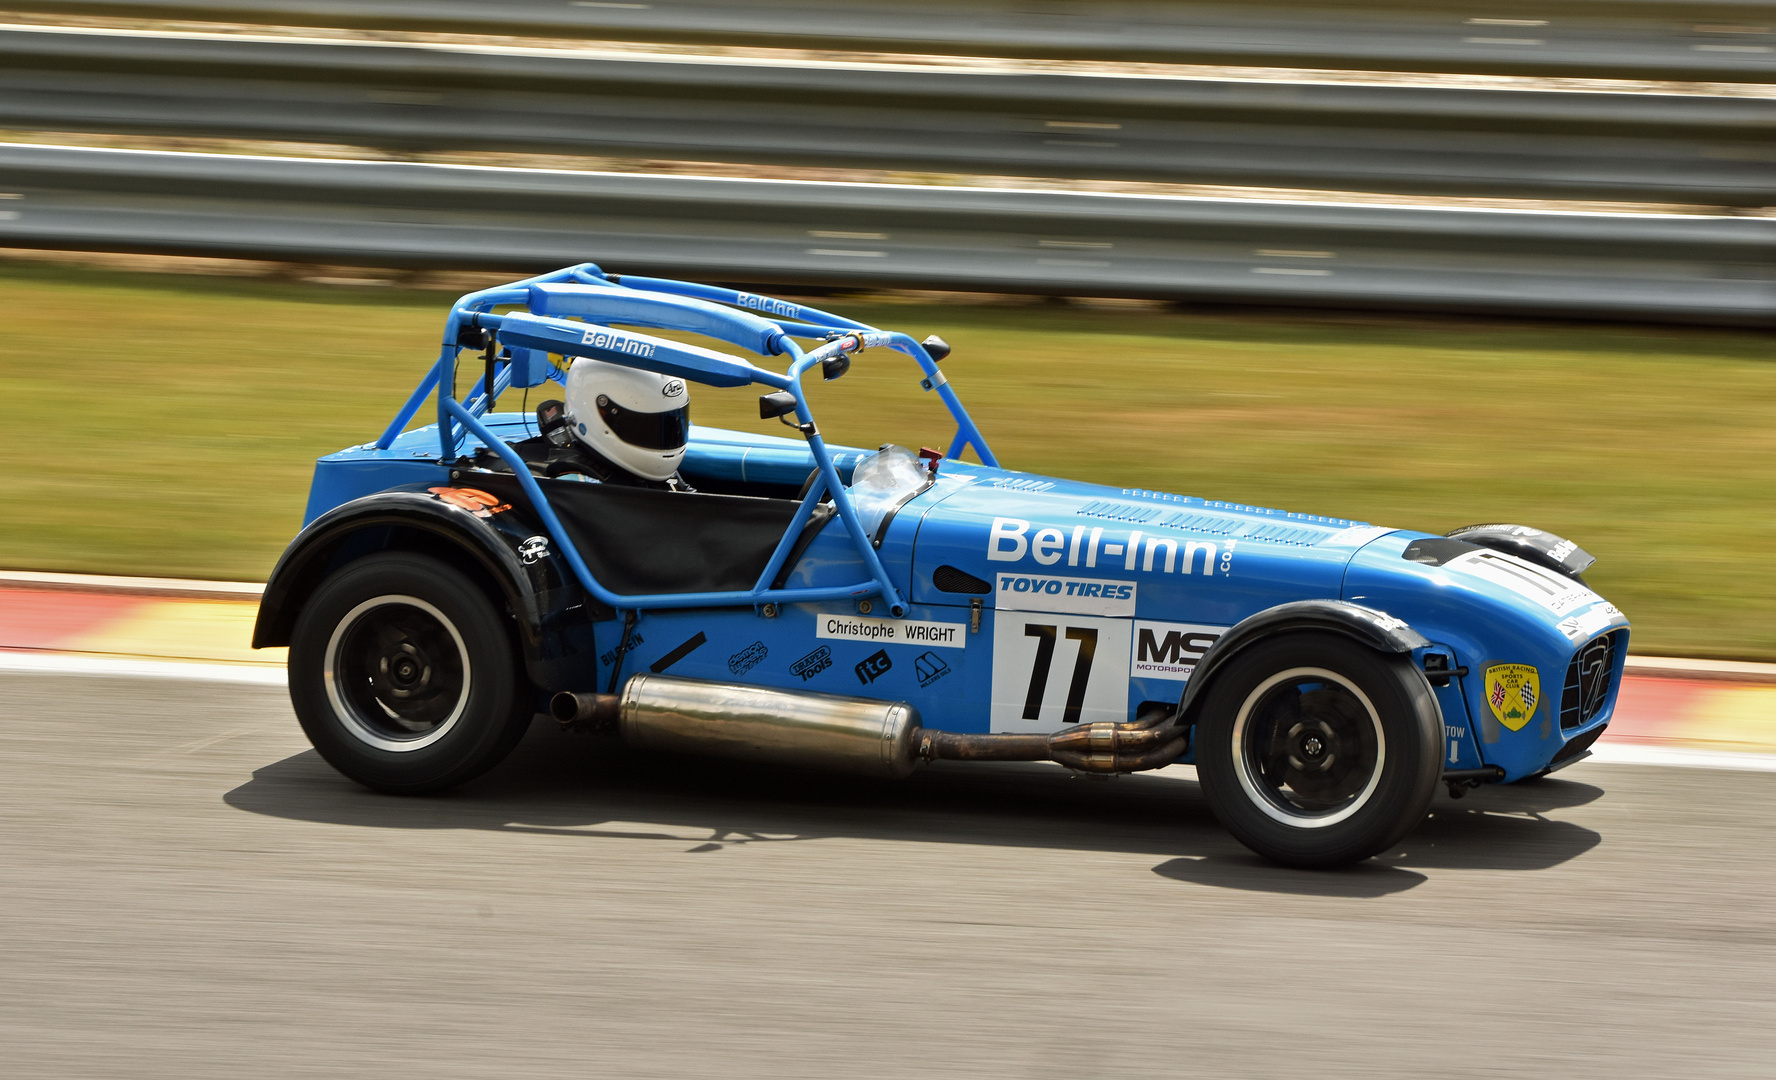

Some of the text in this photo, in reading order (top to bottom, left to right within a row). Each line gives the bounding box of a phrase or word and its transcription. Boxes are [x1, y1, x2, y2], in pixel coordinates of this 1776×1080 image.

[737, 292, 796, 318] Bell-Inn
[581, 329, 651, 357] Bell-Inn
[987, 517, 1218, 576] Bell-Inn
[1000, 577, 1134, 600] TOYO TIRES
[827, 619, 956, 642] Christophe WRIGHT
[601, 633, 645, 667] BILEIN
[792, 648, 828, 674] DRAPER
[799, 656, 833, 682] Tools
[1022, 623, 1098, 723] 77
[1489, 665, 1535, 674] BRITISH RACING
[1445, 725, 1465, 738] TOW
